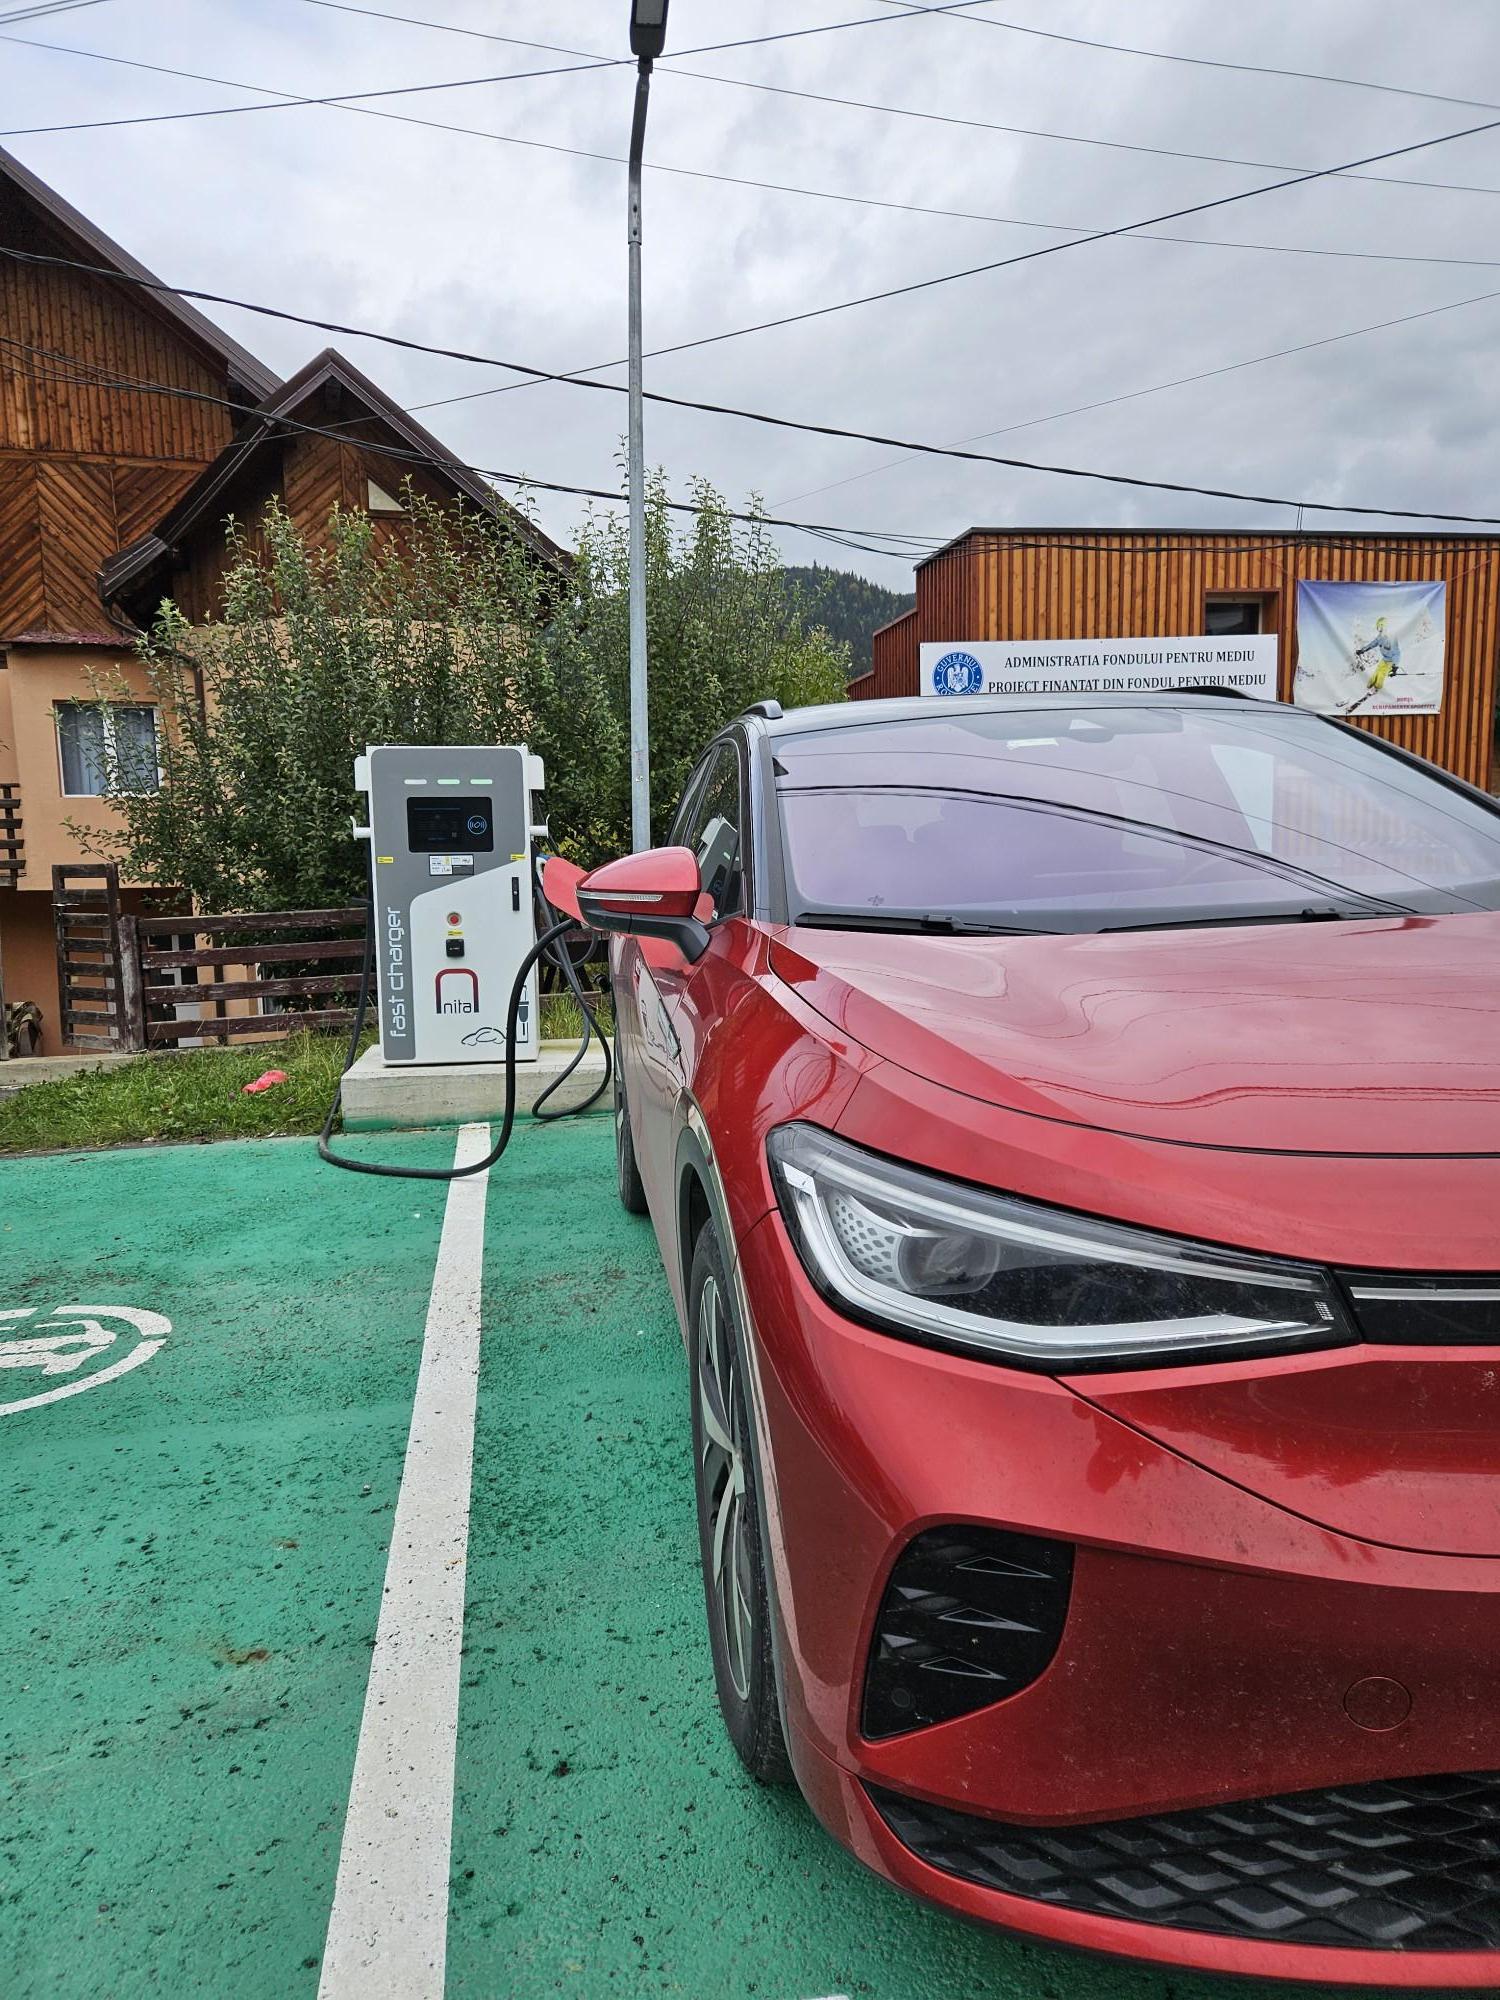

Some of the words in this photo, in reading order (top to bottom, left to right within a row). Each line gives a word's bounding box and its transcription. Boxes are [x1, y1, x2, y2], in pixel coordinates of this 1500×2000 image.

[937, 654, 978, 672] GUVERNUL
[1004, 655, 1099, 669] ADMINISTRATIA
[1103, 654, 1163, 665] FONDULUI
[1166, 651, 1213, 663] PENTRU
[1217, 650, 1255, 662] MEDIU
[1042, 678, 1099, 692] FINANTAT
[1103, 678, 1124, 690] DIN
[1128, 676, 1175, 689] FONDUL
[1178, 675, 1225, 687] PENTRU
[1228, 674, 1266, 686] MEDIU
[387, 907, 405, 990] charger
[390, 995, 406, 1037] fast
[444, 1000, 471, 1014] nita
